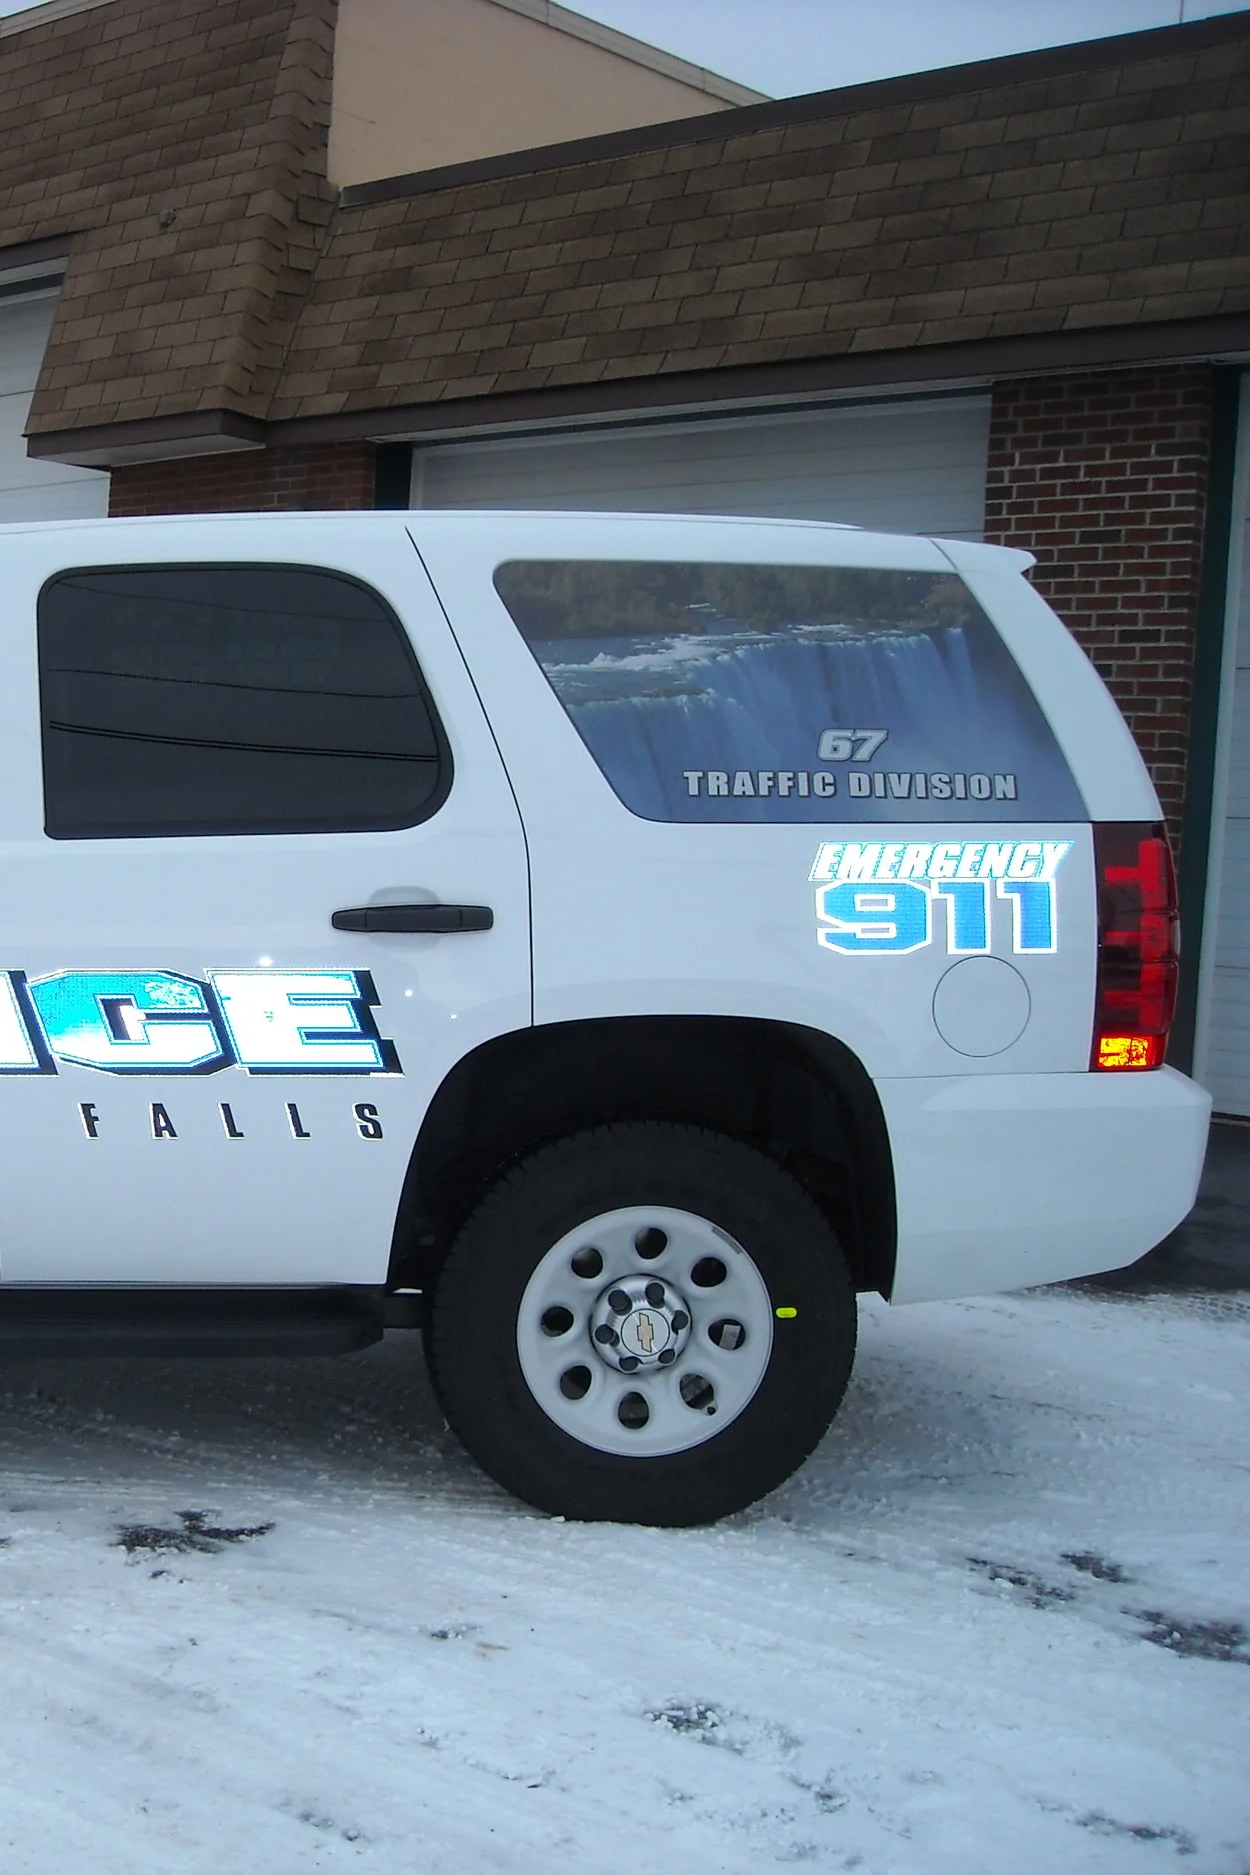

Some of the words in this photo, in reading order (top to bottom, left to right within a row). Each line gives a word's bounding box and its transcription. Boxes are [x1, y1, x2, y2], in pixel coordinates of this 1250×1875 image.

[817, 728, 889, 762] 67
[683, 771, 837, 798] TRAFFIC
[849, 773, 1018, 801] DIVISION
[808, 841, 1073, 881] EMERGENCY
[815, 878, 1058, 955] 911
[77, 1102, 384, 1140] FALLS
